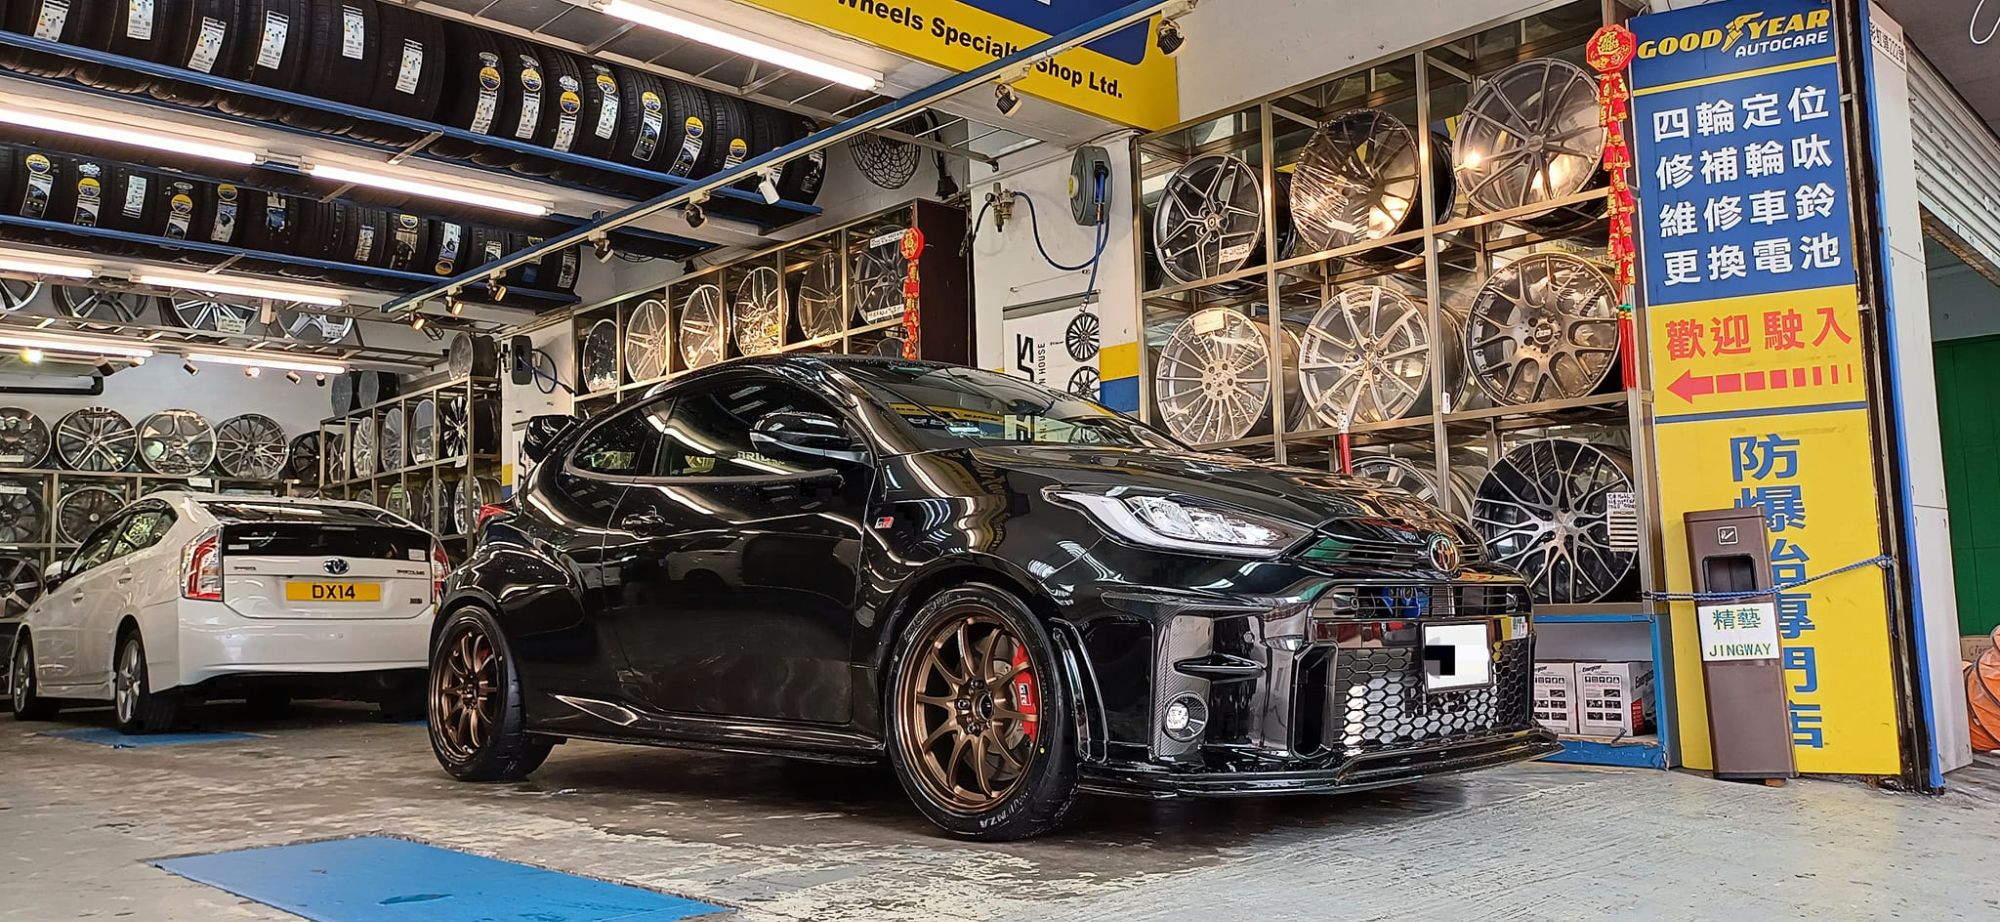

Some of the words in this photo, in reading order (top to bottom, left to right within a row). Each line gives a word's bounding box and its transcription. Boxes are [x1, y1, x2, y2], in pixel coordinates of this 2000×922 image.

[931, 17, 1022, 59] Specialt
[1035, 57, 1084, 87] Shop
[1089, 70, 1123, 99] Ltd.
[1735, 30, 1829, 59] AUTOCARE
[1653, 85, 1829, 143] 四輪定位
[1655, 133, 1833, 192] 修補輪呔
[1659, 181, 1836, 239] 維修車鈴
[1663, 232, 1842, 287] 更換電池
[1037, 343, 1046, 375] HOUSE
[312, 584, 356, 599] DX14
[1712, 607, 1762, 630] 精藝
[1709, 642, 1771, 657] JINGWAY
